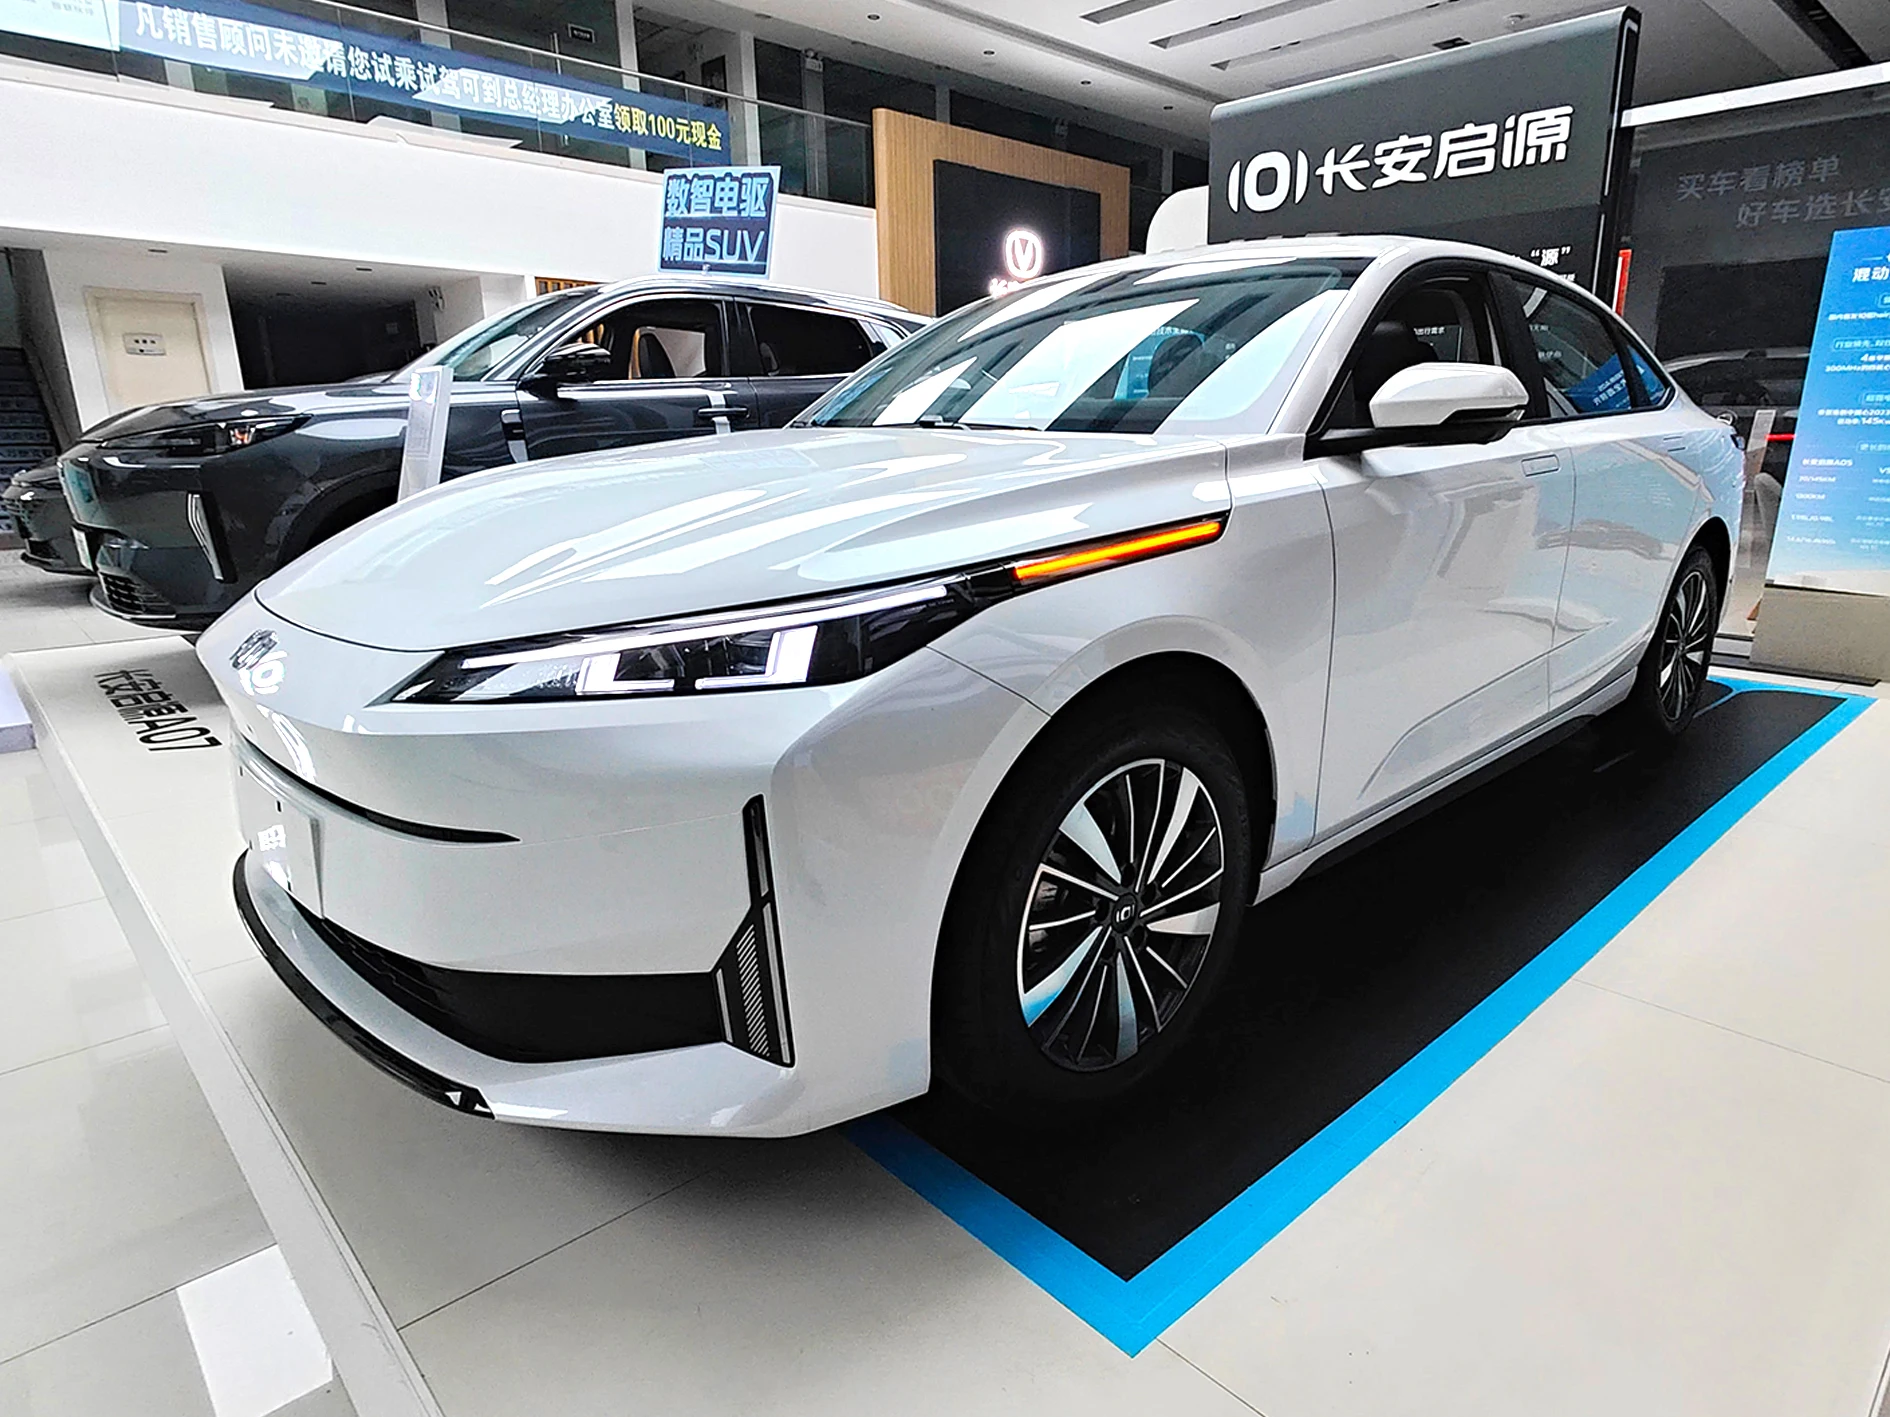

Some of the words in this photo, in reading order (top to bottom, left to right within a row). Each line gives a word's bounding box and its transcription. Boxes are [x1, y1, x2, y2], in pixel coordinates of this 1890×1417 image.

[1315, 104, 1574, 195] 长安启源
[664, 174, 769, 219] 数智电驱
[1677, 154, 1841, 200] 买车看榜单
[662, 226, 766, 263] 精品SUV
[94, 668, 223, 752] 长安启源A07
